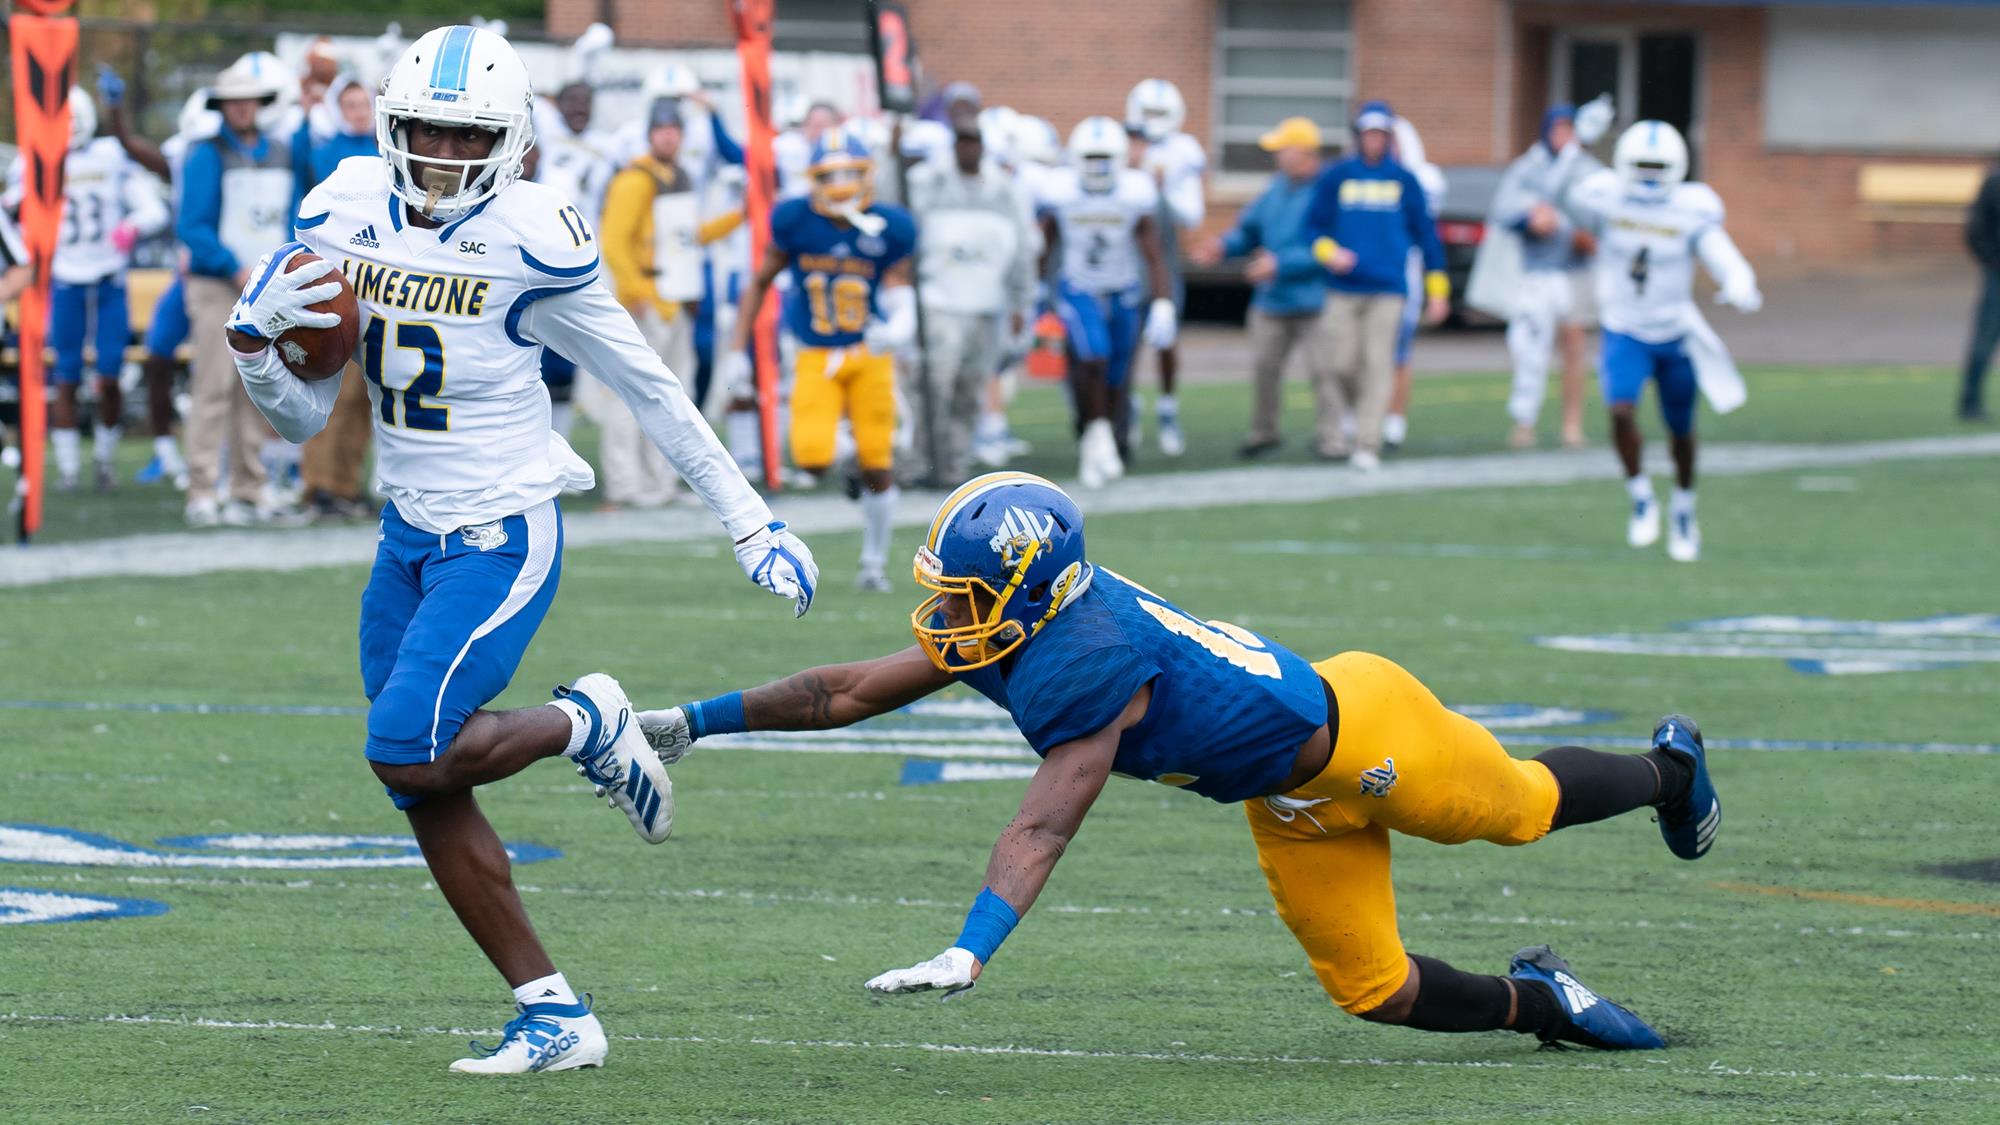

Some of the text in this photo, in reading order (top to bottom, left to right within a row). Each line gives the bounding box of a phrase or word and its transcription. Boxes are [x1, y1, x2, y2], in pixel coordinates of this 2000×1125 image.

[349, 236, 381, 249] adidas
[458, 240, 487, 256] SAC
[557, 205, 593, 249] 12
[1628, 244, 1650, 297] 4
[802, 272, 871, 334] 16
[362, 313, 452, 433] 12
